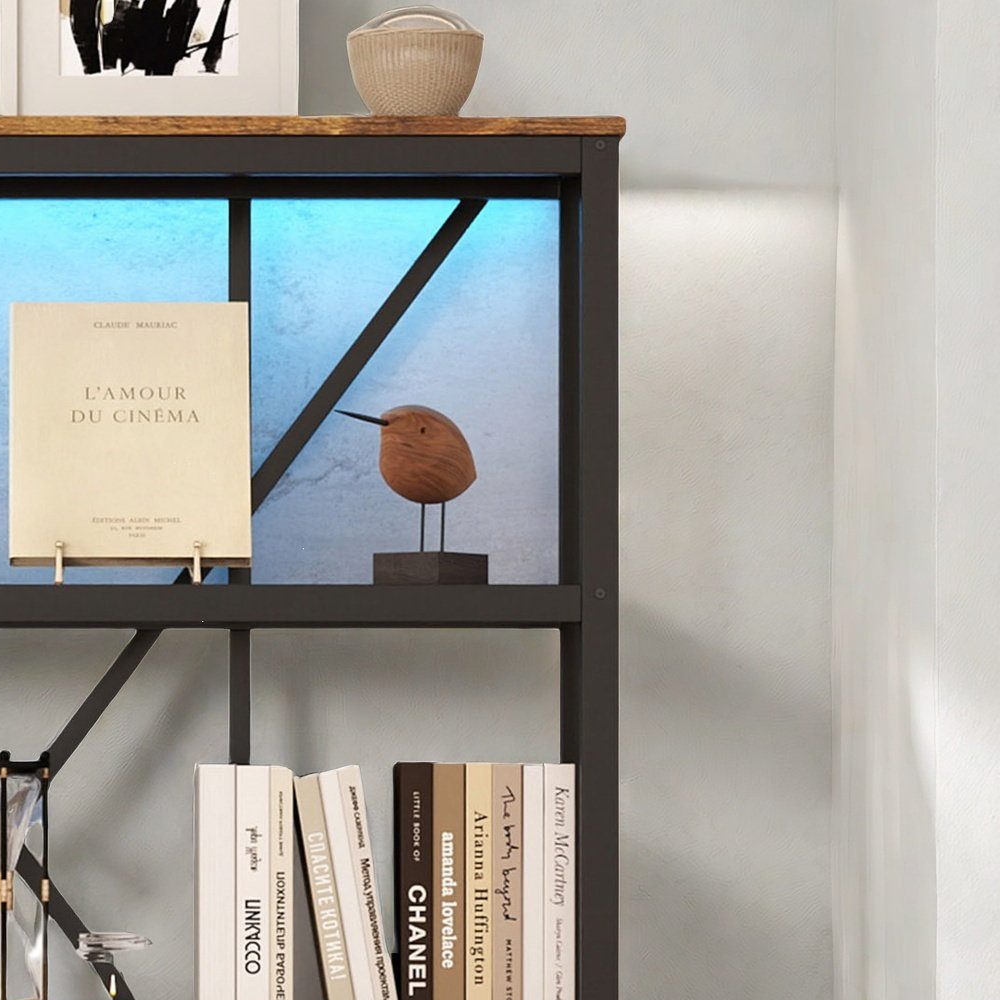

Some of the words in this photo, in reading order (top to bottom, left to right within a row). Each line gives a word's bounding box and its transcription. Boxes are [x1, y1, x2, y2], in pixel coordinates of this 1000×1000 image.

[93, 321, 130, 329] CLAUDE
[136, 321, 178, 329] MAURIAC
[71, 409, 102, 423] DU
[113, 407, 200, 423] CINÉMA
[84, 386, 187, 401] L'AMOUR
[501, 785, 516, 819] The
[555, 786, 569, 827] Karen
[308, 831, 334, 906] СПАСИТЕ
[413, 849, 420, 861] OF
[441, 832, 457, 897] amanda
[474, 811, 489, 880] Arianna
[501, 825, 520, 860] body
[550, 832, 569, 907] McCartney
[360, 858, 371, 892] Метод
[494, 868, 518, 922] beyond
[320, 909, 347, 981] КОТИКА!
[363, 892, 383, 955] управления
[408, 885, 427, 996] CHANEL
[441, 901, 457, 969] lovelace
[469, 889, 489, 985] Huffington
